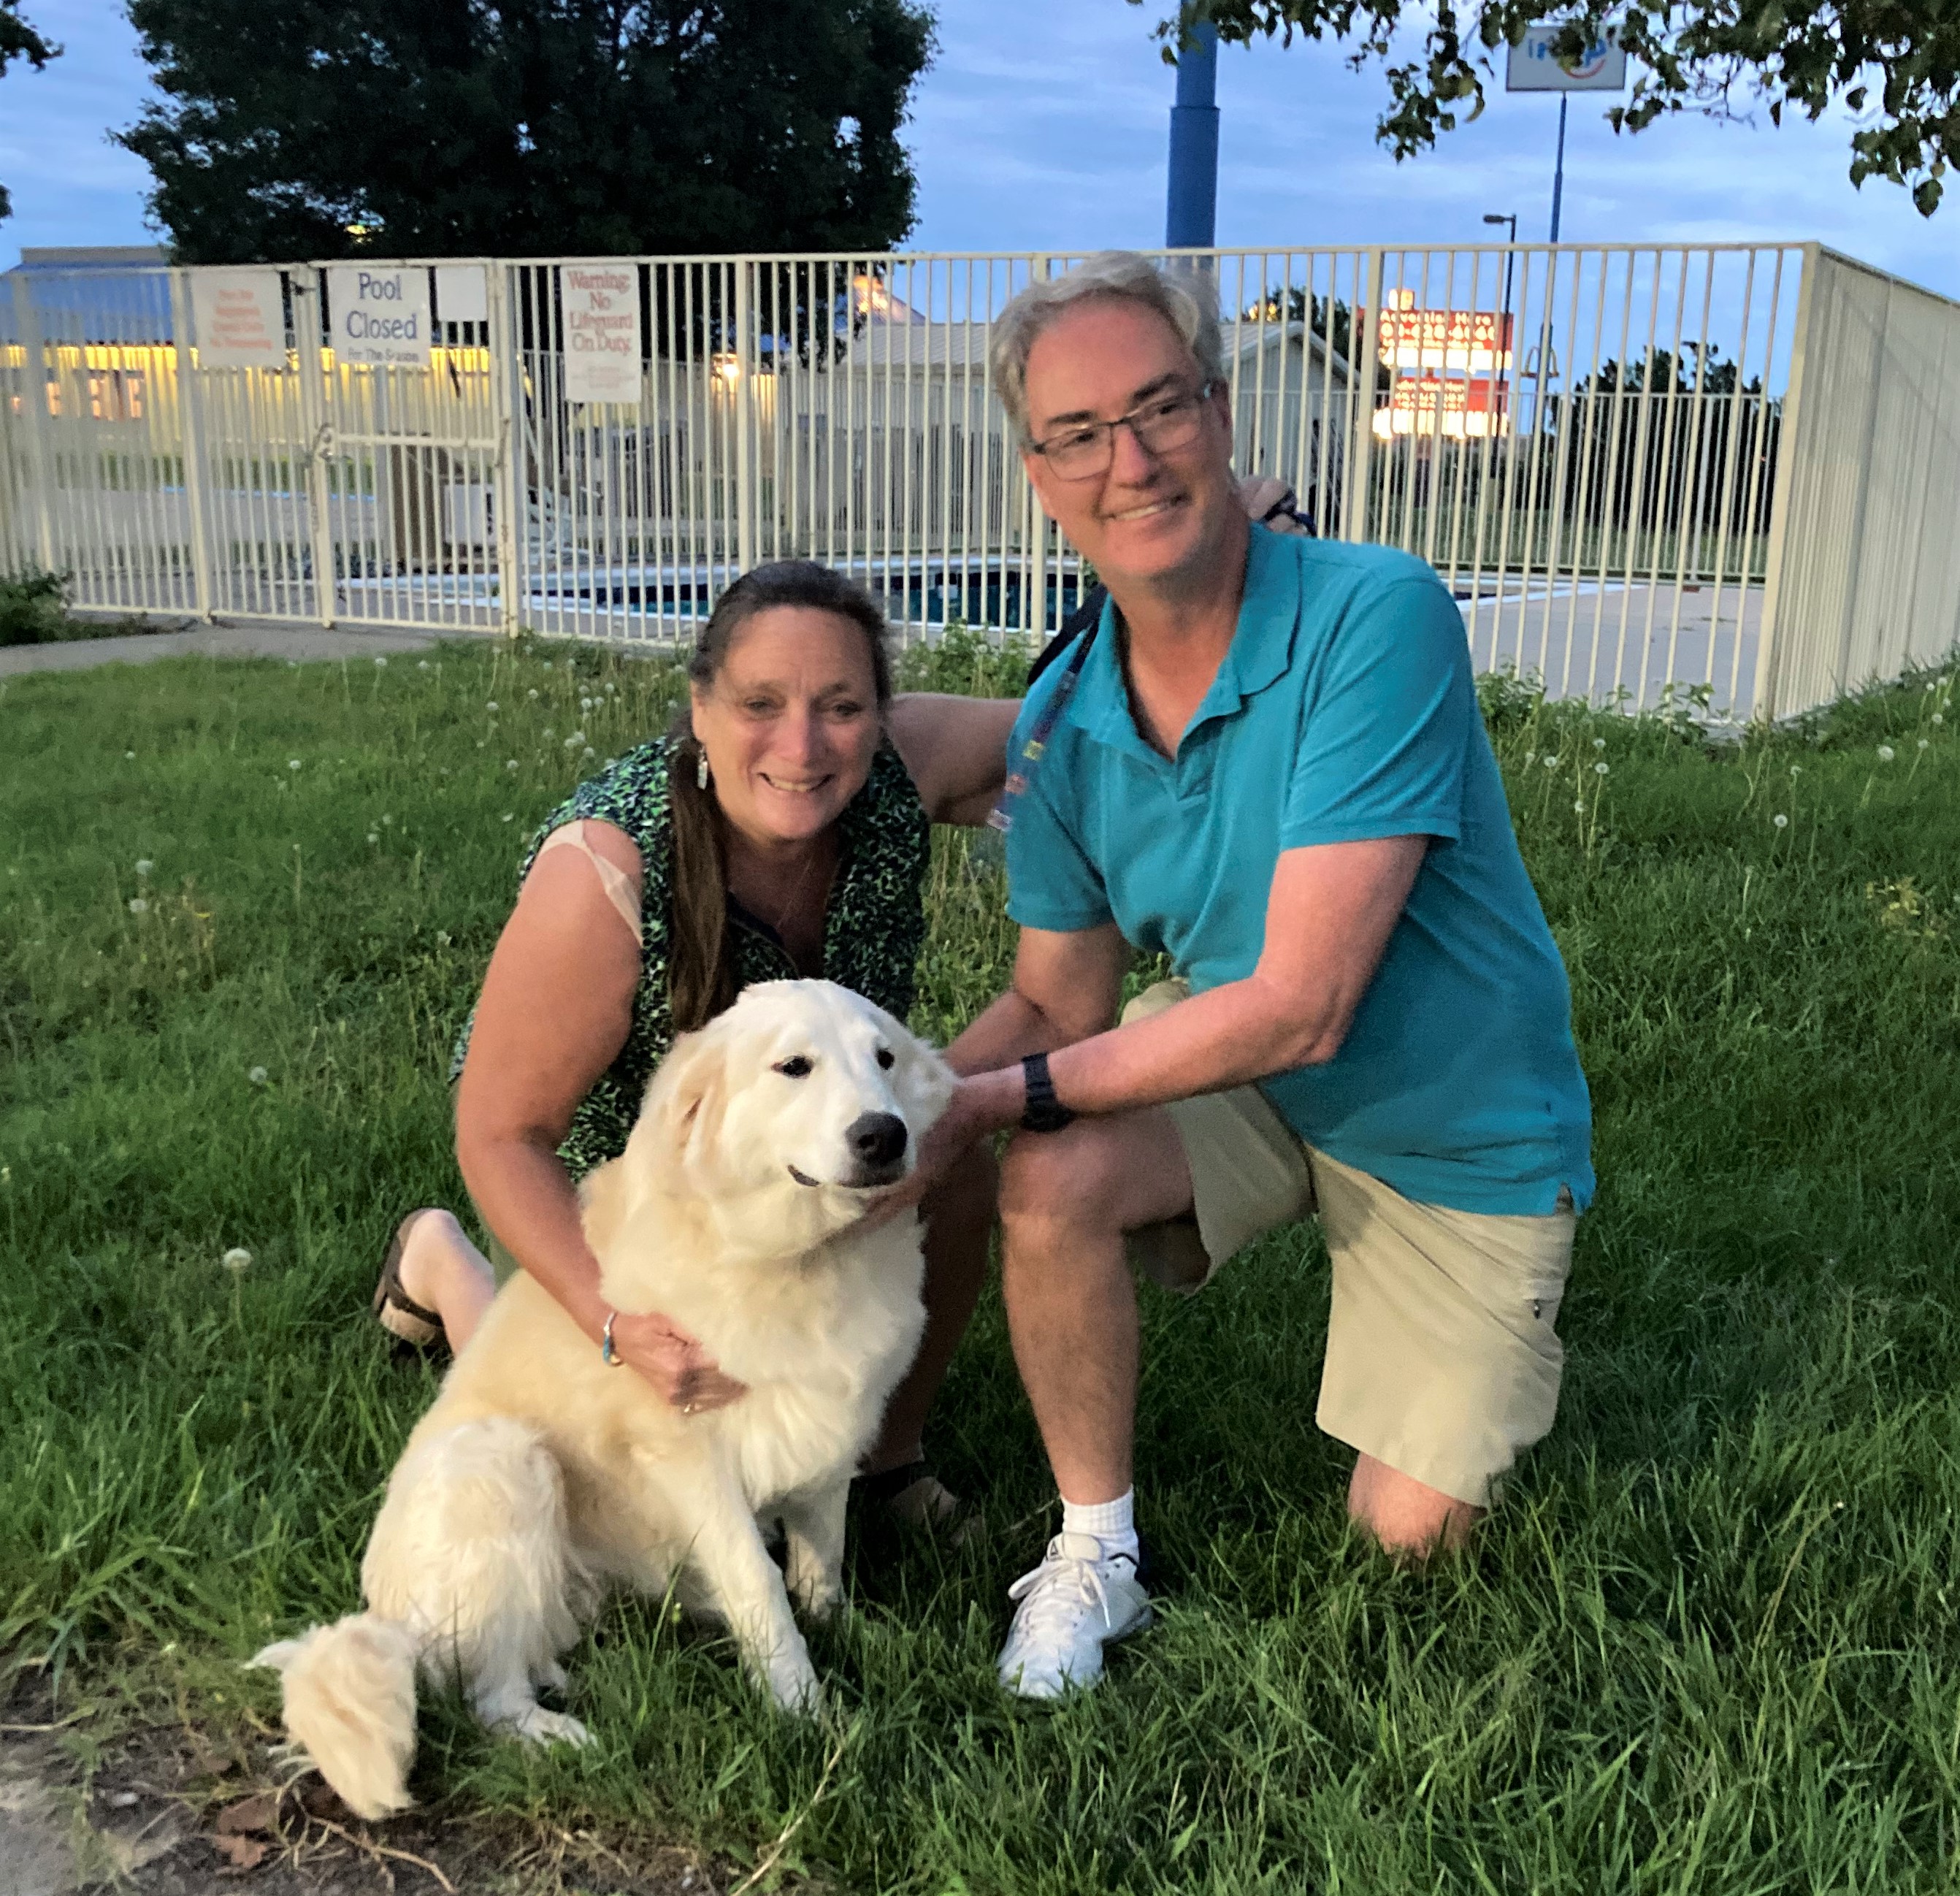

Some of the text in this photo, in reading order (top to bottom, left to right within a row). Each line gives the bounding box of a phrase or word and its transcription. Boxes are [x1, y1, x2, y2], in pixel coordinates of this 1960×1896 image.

[358, 272, 402, 300] Pool
[589, 291, 611, 310] No
[346, 310, 417, 340] Closed
[573, 333, 594, 351] On
